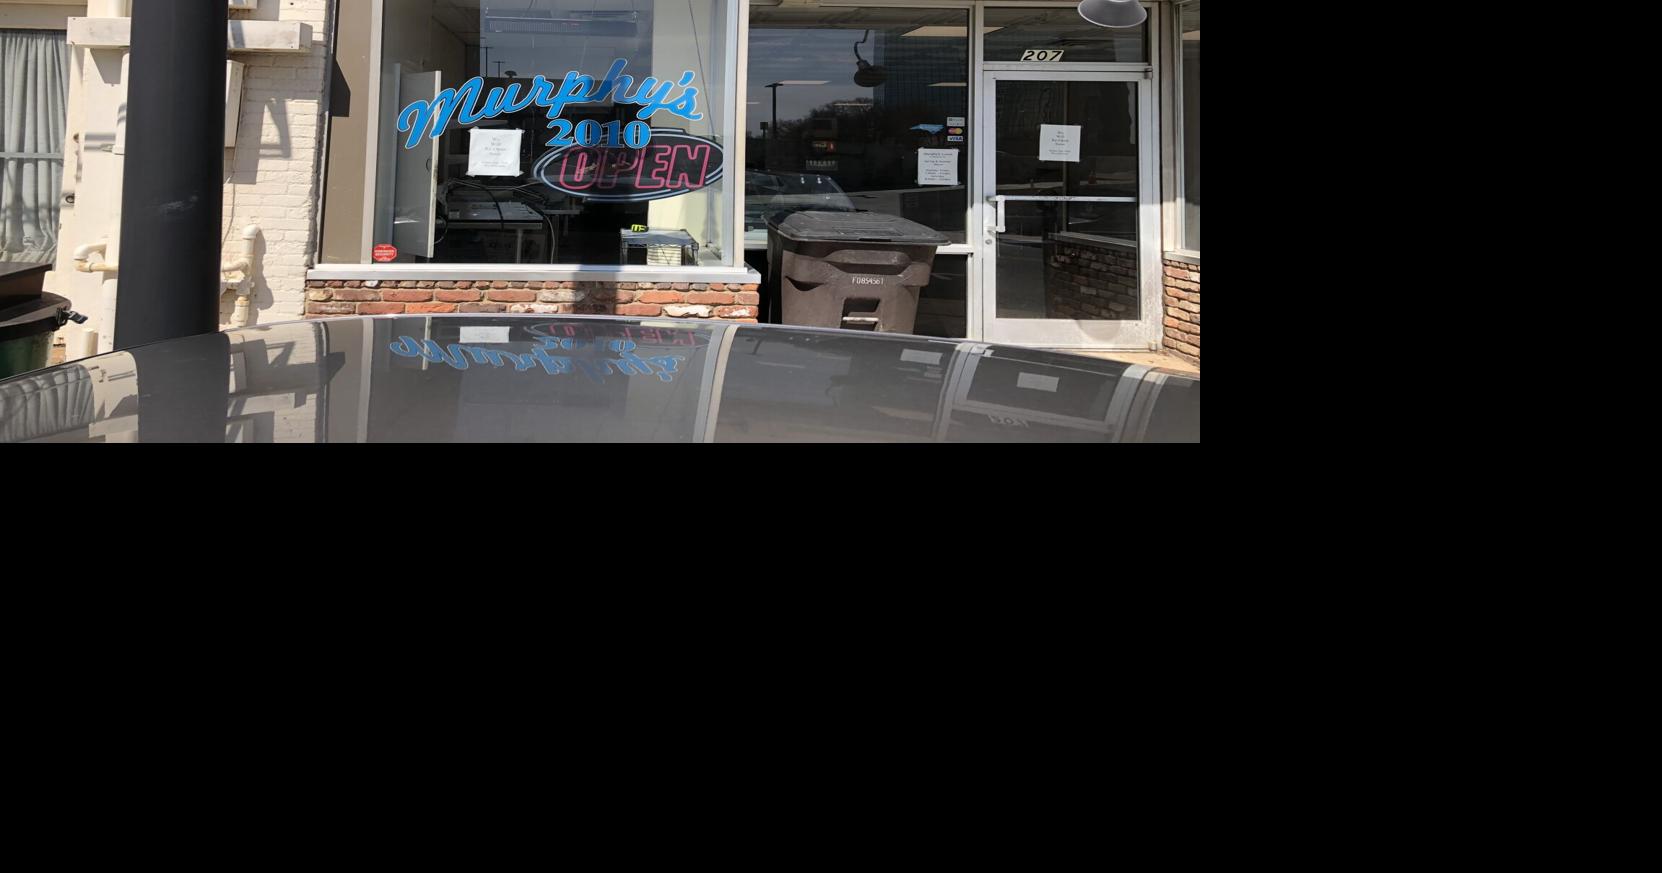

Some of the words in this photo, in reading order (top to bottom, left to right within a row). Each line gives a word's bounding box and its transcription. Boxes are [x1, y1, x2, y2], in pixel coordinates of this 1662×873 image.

[1023, 50, 1062, 61] 207
[397, 58, 703, 149] Murphy's
[545, 119, 652, 149] 2010
[559, 143, 711, 190] OPEN
